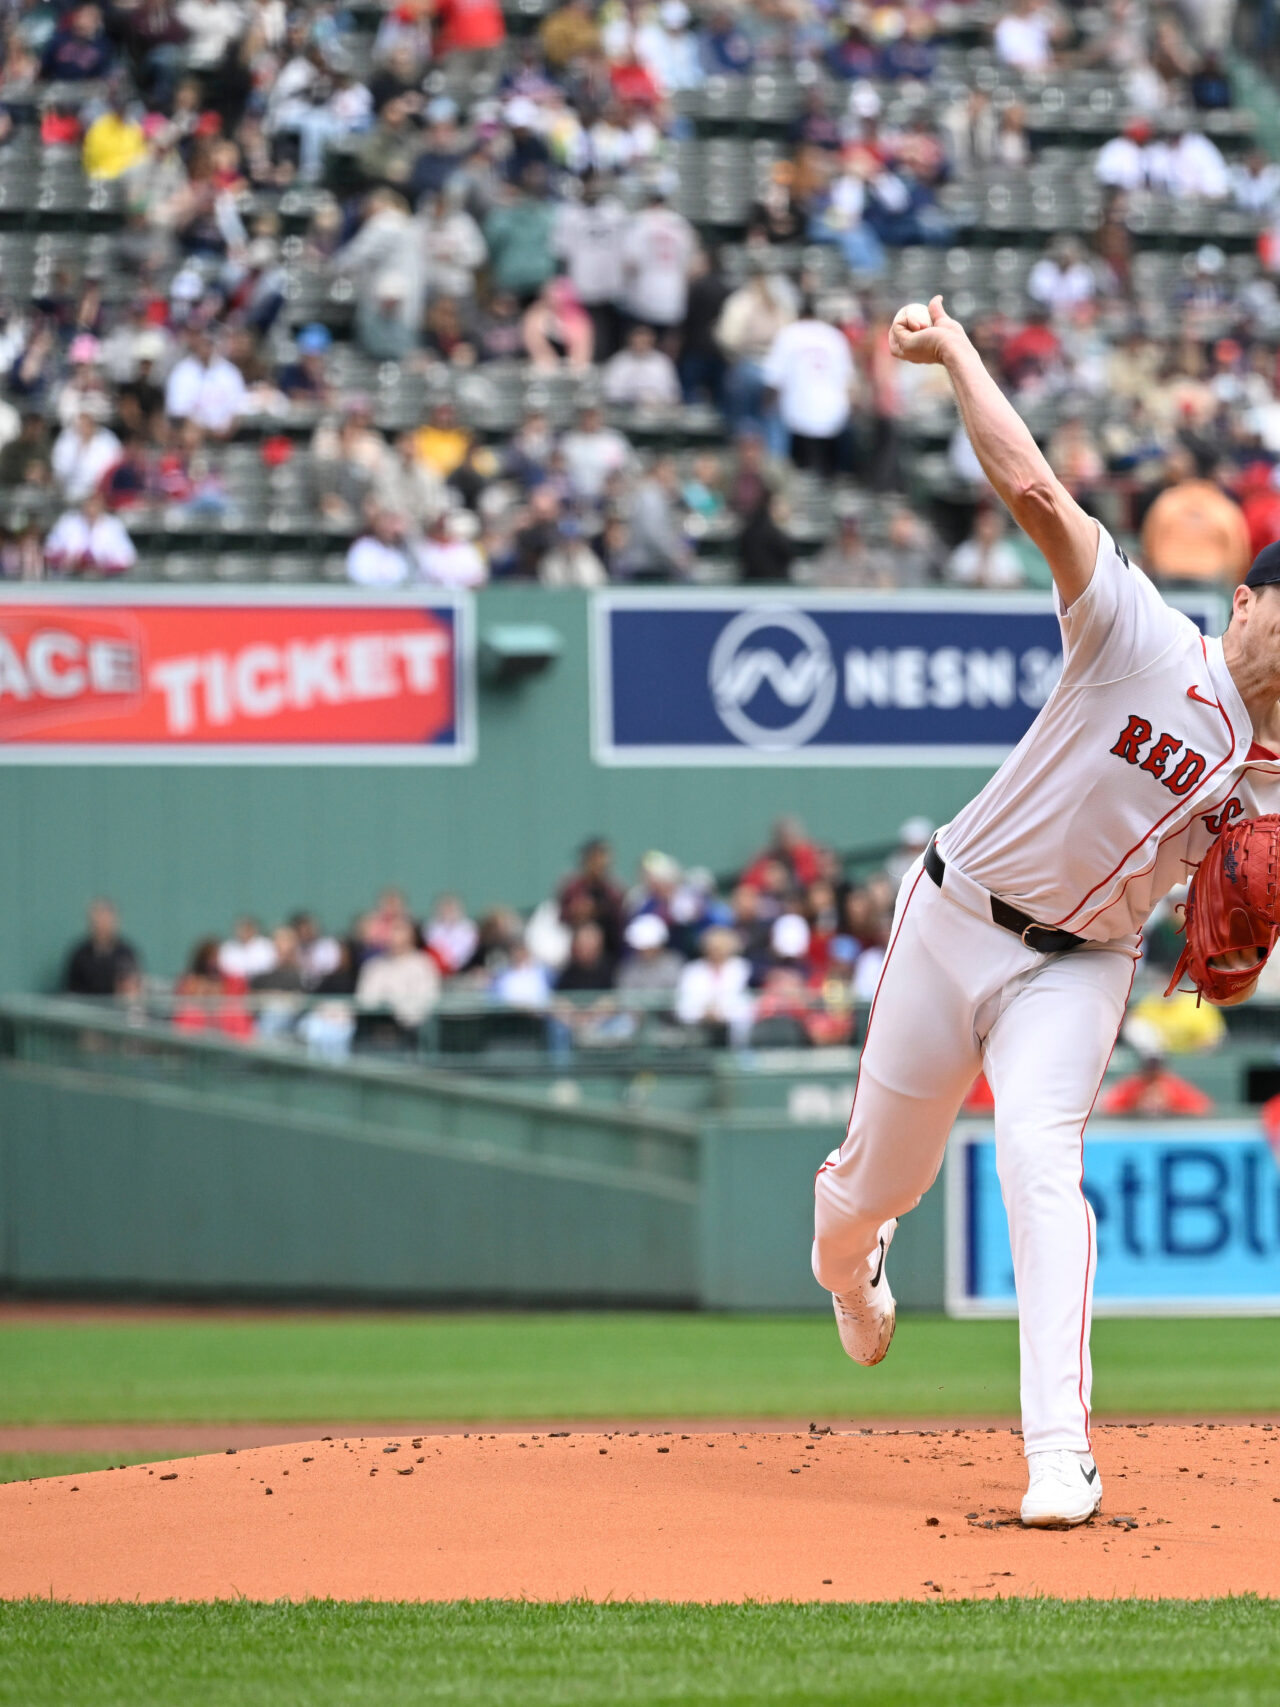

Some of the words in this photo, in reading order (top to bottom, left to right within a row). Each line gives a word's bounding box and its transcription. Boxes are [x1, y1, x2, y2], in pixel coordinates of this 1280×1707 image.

[152, 630, 449, 733] TICKET
[845, 647, 1015, 708] NESN
[1110, 714, 1206, 795] RED
